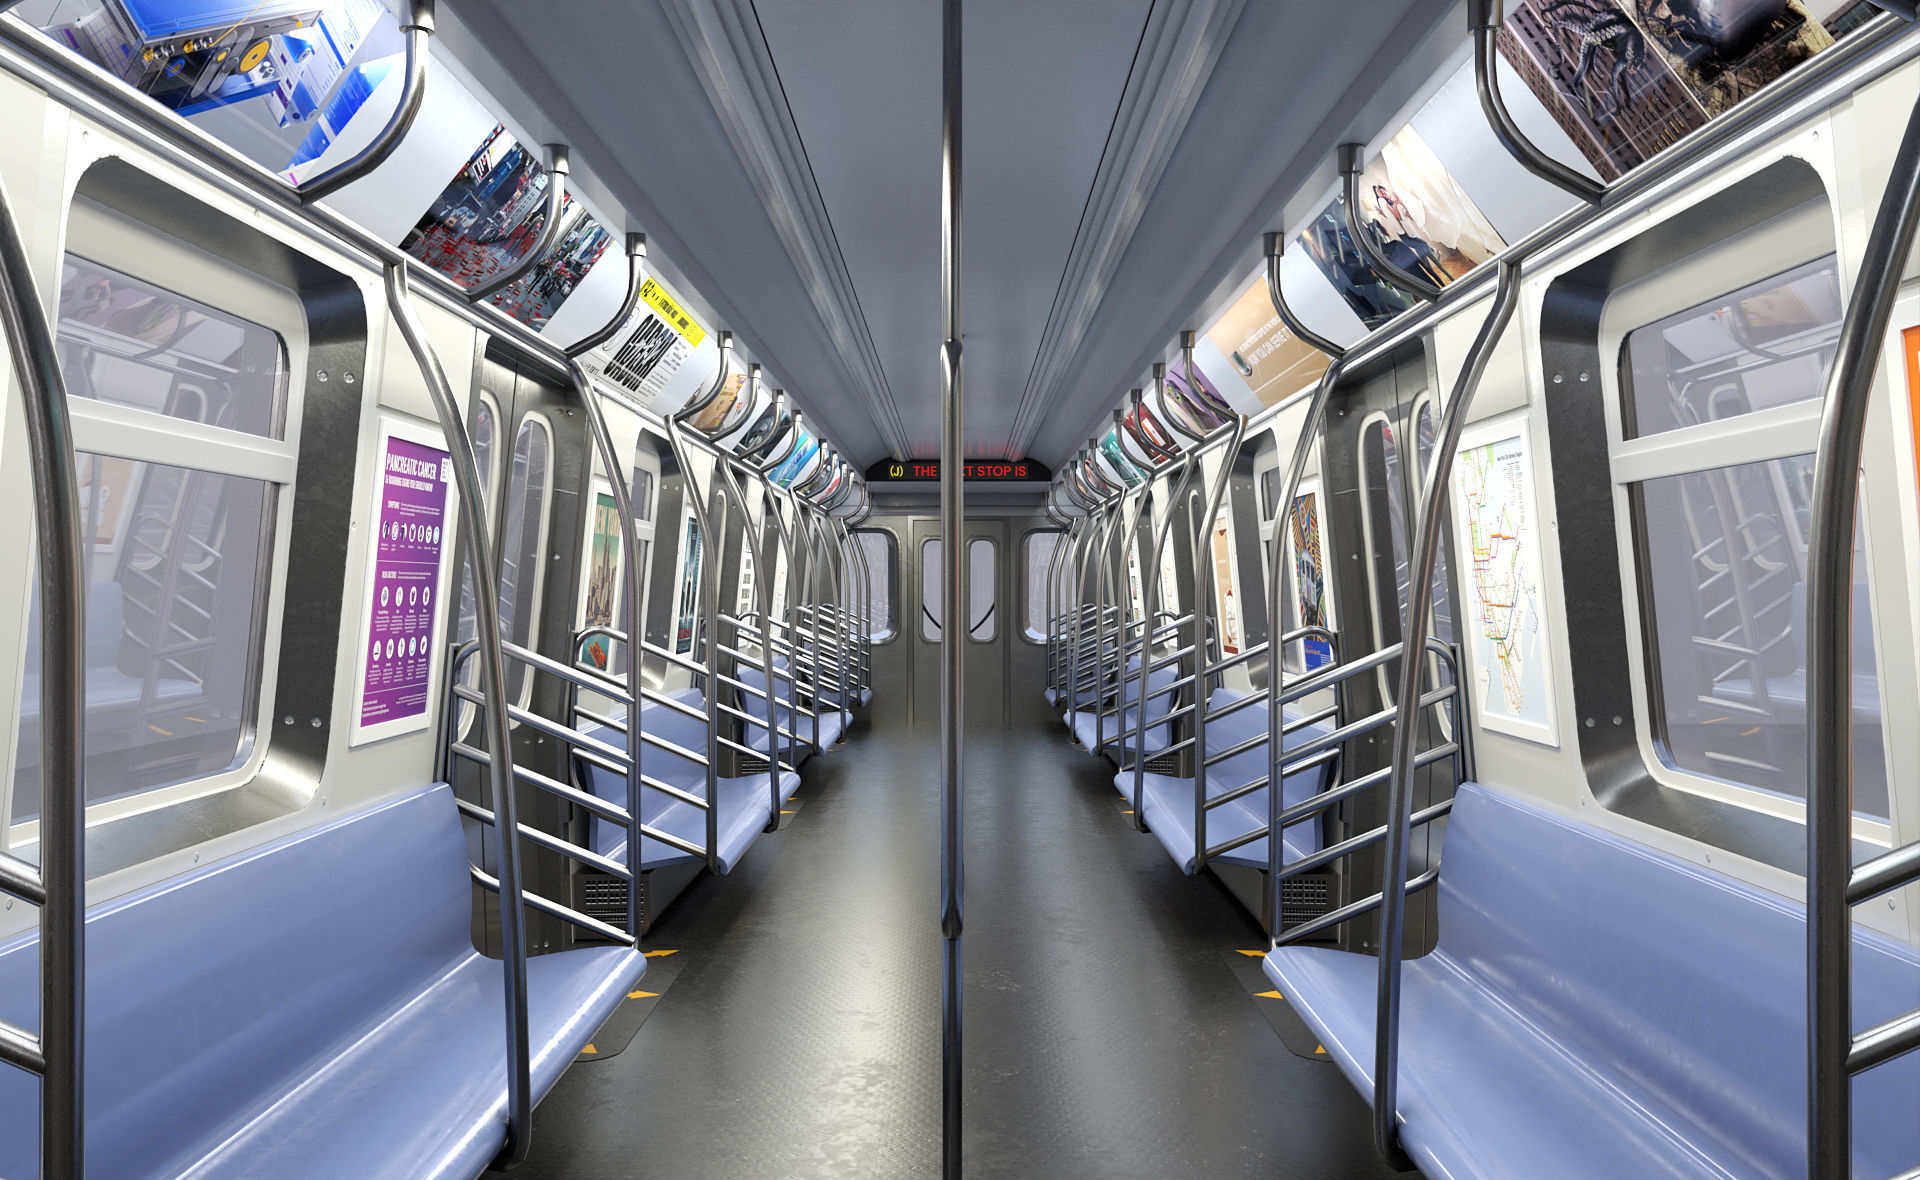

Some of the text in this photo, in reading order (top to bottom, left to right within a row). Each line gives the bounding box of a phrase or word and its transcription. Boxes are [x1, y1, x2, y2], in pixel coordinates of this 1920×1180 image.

[386, 453, 418, 476] PANCREATIC
[418, 460, 437, 480] CANCER
[890, 465, 904, 478] (J)
[912, 465, 937, 477] THE
[977, 465, 1012, 477] STOP
[1015, 465, 1027, 477] IS
[594, 504, 608, 535] NEW
